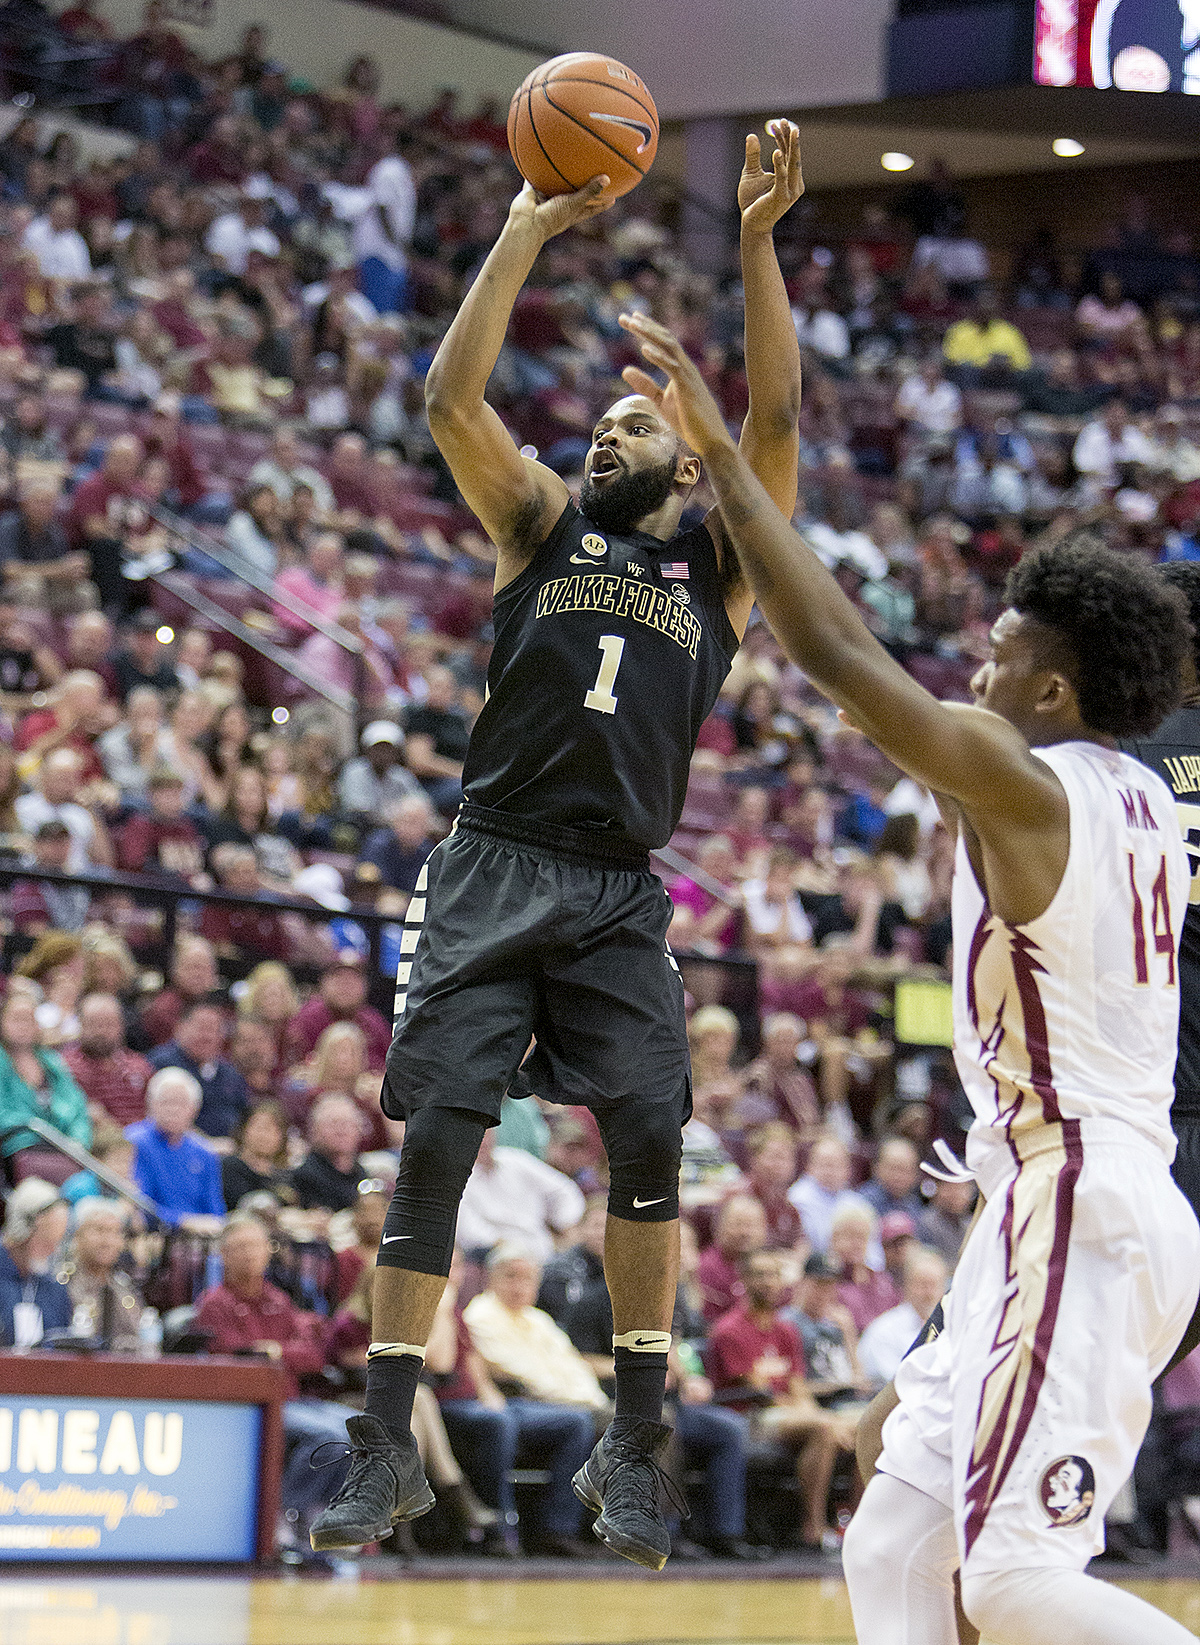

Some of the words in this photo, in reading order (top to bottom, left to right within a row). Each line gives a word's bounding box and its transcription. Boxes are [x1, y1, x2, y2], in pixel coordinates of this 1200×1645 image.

[626, 561, 645, 577] WF
[536, 574, 621, 619] WAKE
[616, 578, 702, 660] FOREST
[583, 634, 625, 715] 1
[1125, 849, 1176, 988] 14
